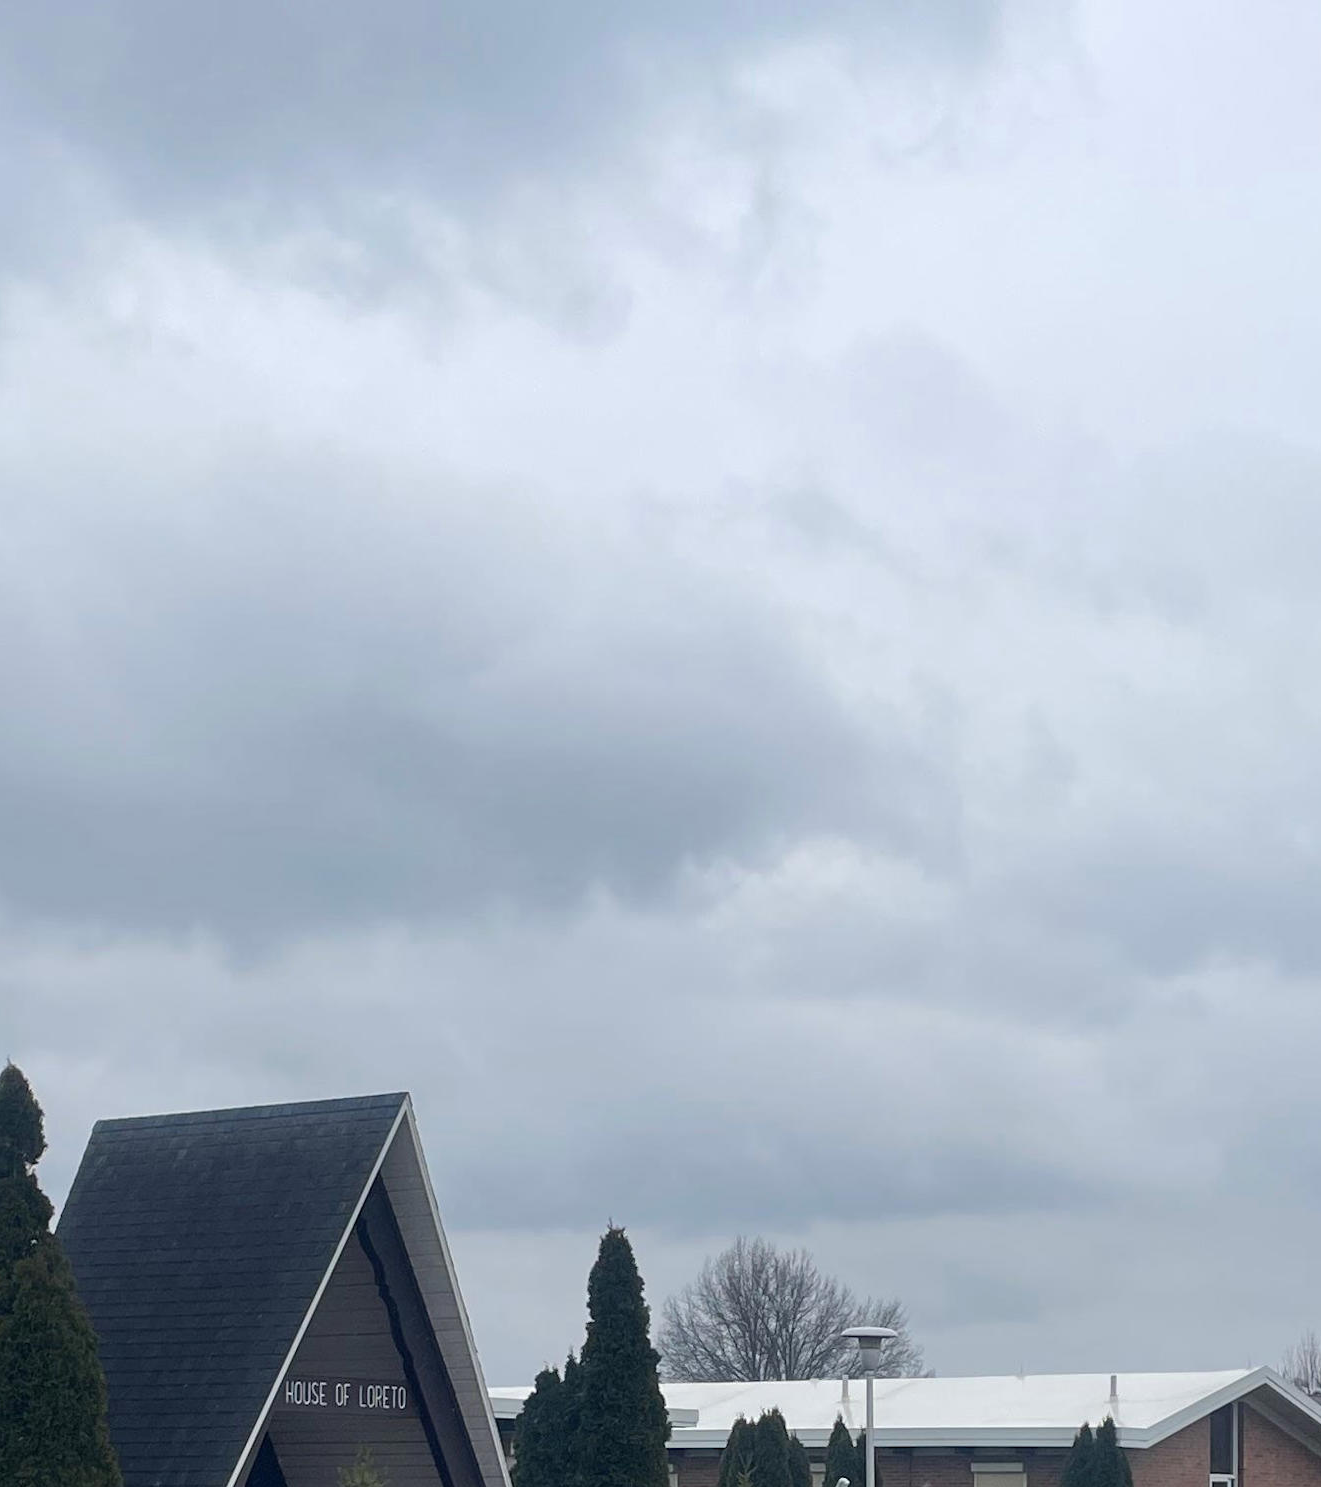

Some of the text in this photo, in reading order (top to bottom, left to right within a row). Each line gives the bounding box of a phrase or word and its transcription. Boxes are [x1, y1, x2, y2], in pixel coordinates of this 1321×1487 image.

[284, 1380, 407, 1410] HOUSE OF LORETO
